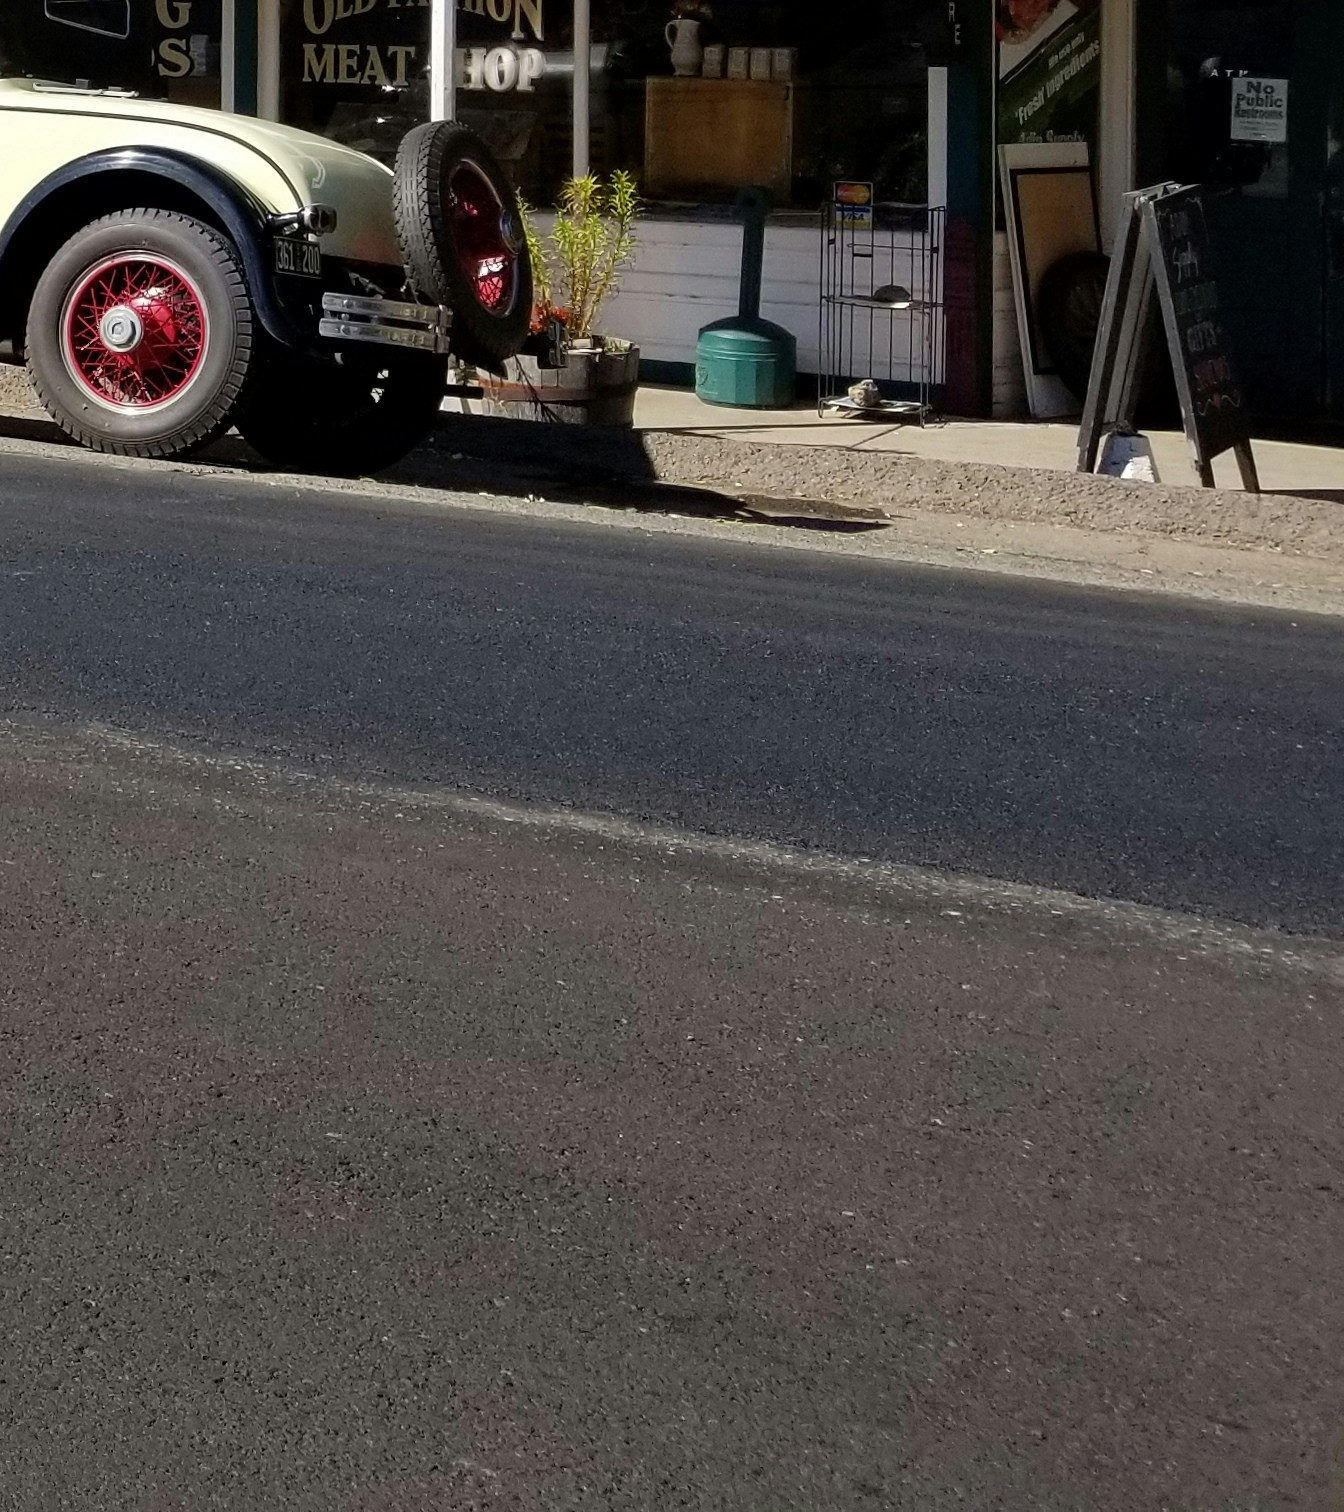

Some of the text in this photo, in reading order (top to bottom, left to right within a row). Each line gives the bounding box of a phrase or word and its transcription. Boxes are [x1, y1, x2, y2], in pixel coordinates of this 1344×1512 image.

[302, 43, 547, 92] MEAT HOP
[1247, 81, 1274, 94] No
[1237, 93, 1283, 108] Public
[278, 241, 295, 270] 361
[302, 245, 320, 274] 200
